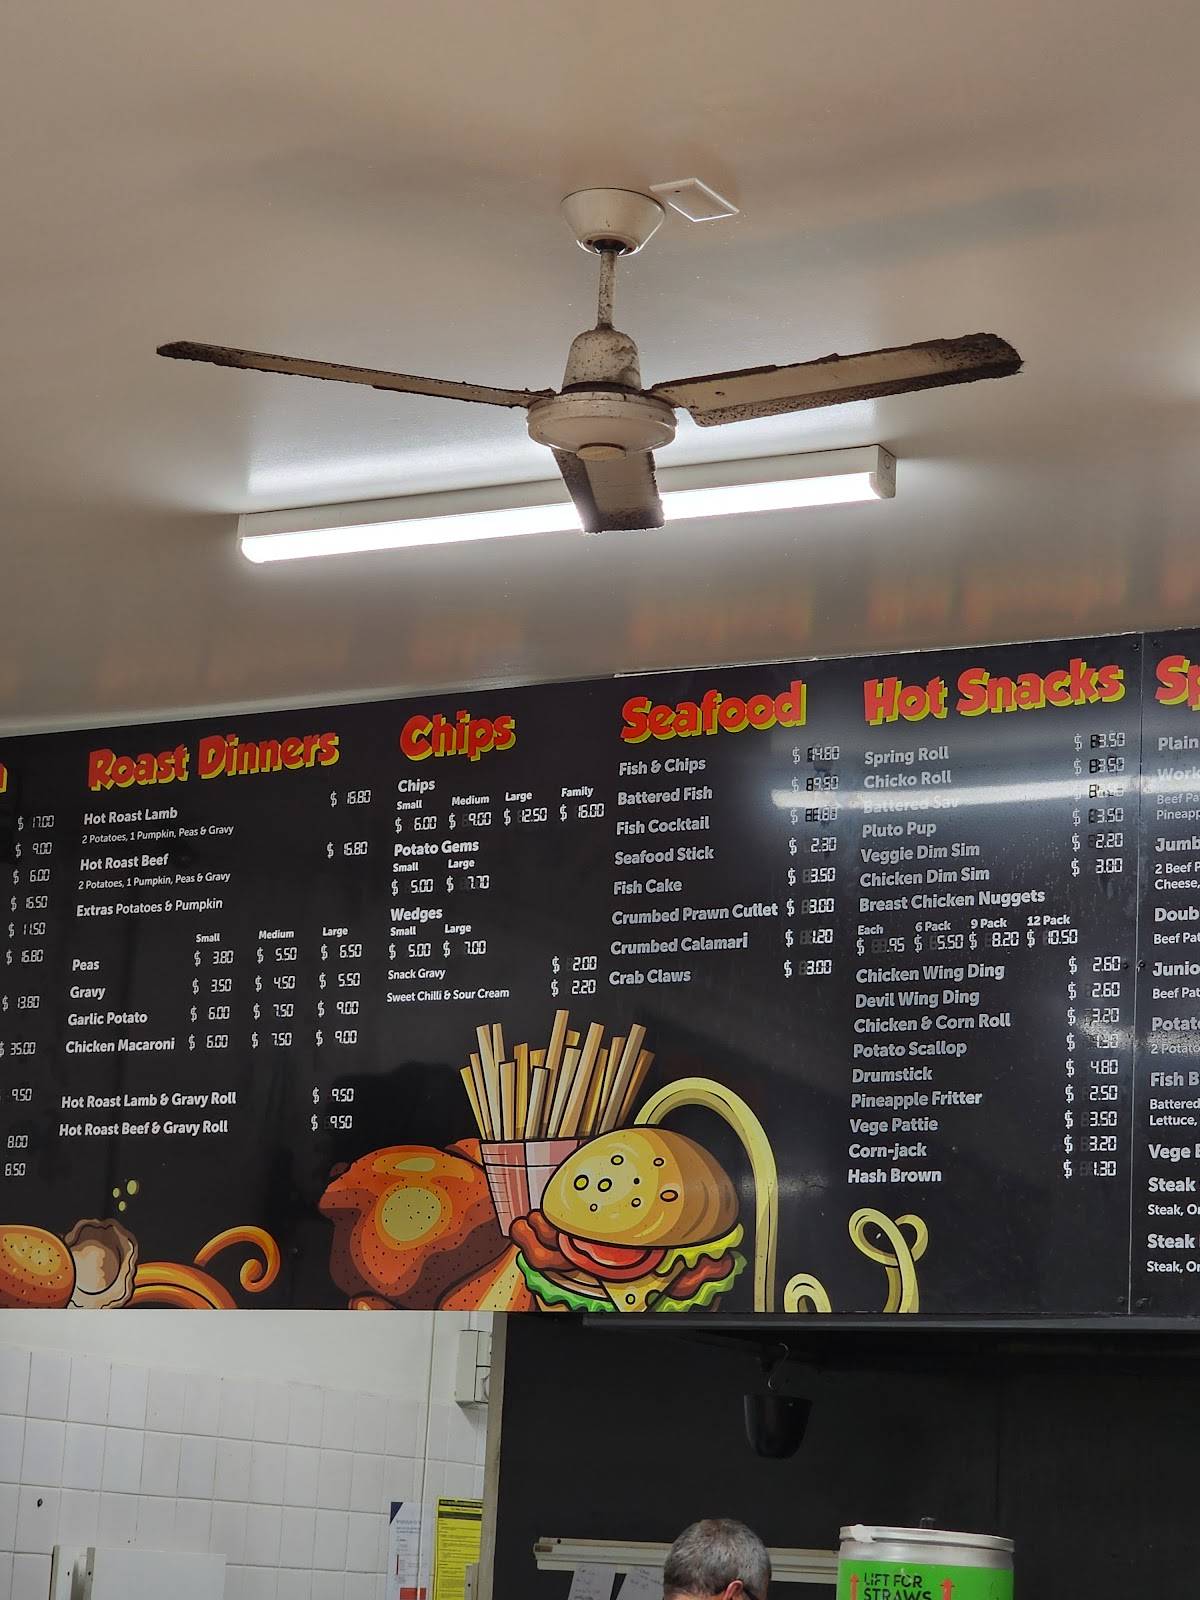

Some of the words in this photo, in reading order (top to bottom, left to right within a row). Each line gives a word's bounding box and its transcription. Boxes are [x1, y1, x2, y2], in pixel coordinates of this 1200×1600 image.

[863, 676, 948, 726] Hot
[956, 658, 1126, 717] Snacks
[620, 679, 807, 744] Seafood
[399, 709, 516, 762] Chips
[1159, 736, 1199, 751] Plain
[88, 744, 190, 792] Roast
[198, 732, 339, 780] Dinners
[865, 750, 914, 767] Spring
[918, 746, 949, 761] Roll
[619, 761, 647, 776] Fish
[651, 760, 661, 773] &
[664, 758, 706, 774] Chips
[398, 779, 435, 794] Chips
[864, 773, 917, 788] Chicko
[921, 770, 951, 784] Roll
[397, 800, 422, 810] Small
[452, 795, 489, 806] Medium
[505, 792, 532, 802] Large
[561, 786, 593, 797] Family
[618, 788, 680, 805] Battered
[684, 786, 712, 800] Fish
[84, 813, 106, 825] Hot
[109, 810, 142, 823] Roast
[145, 807, 177, 820] Lamb
[617, 821, 645, 835] Fish
[648, 816, 709, 833] Cocktail
[863, 824, 903, 838] Pluto
[907, 822, 936, 837] Pup
[82, 835, 87, 844] 2
[89, 833, 128, 843] Potatoes,
[137, 829, 176, 840] Pumpkin,
[179, 828, 198, 837] Peas
[200, 826, 206, 835] &
[208, 825, 234, 835] Gravy
[394, 843, 439, 856] Potato
[441, 840, 479, 853] Gems
[615, 848, 674, 865] Seafood
[677, 846, 714, 861] Stick
[861, 847, 913, 865] Veggie
[917, 845, 947, 859] Dim
[951, 843, 979, 857] Sim
[80, 859, 102, 870] Hot
[105, 856, 139, 869] Roast
[142, 853, 169, 866] Beef
[393, 862, 418, 872] Small
[448, 859, 475, 870] Large
[1155, 864, 1162, 874] 2
[1166, 862, 1192, 873] Beef
[860, 871, 922, 887] Chicken
[927, 869, 957, 883] Dim
[961, 867, 989, 881] Sim
[614, 880, 642, 895] Fish
[646, 878, 682, 893] Cake
[77, 905, 113, 916] Extras
[116, 902, 162, 914] Potatoes
[165, 900, 173, 911] &
[175, 898, 223, 912] Pumpkin
[860, 897, 908, 912] Breast
[911, 893, 974, 909] Chicken
[979, 890, 1045, 907] Nuggets
[391, 907, 442, 923] Wedges
[612, 908, 679, 925] Crumbed
[683, 907, 729, 921] Prawn
[1155, 906, 1199, 922] Doub
[858, 924, 883, 935] Each
[915, 922, 922, 932] 6
[925, 921, 951, 931] Pack
[971, 919, 978, 929] 9
[981, 918, 1007, 928] Pack
[1027, 916, 1040, 926] 12
[1043, 915, 1070, 925] Pack
[196, 933, 220, 942] Small
[259, 930, 294, 939] Medium
[323, 927, 348, 938] Large
[611, 938, 678, 955] Crumbed
[681, 932, 748, 951] Calamari
[72, 959, 99, 971] Peas
[856, 968, 919, 983] Chicken
[923, 965, 964, 982] Wing
[968, 963, 1005, 980] Ding
[388, 969, 416, 980] Snack
[418, 968, 446, 980] Gravy
[609, 970, 644, 985] Crab
[647, 969, 691, 983] Claws
[70, 986, 105, 1000] Gravy
[387, 992, 415, 1002] Sweet
[417, 991, 442, 1001] Chilli
[444, 990, 451, 1000] &
[453, 990, 476, 999] Sour
[477, 988, 509, 998] Cream
[856, 993, 895, 1008] Devil
[898, 991, 938, 1008] Wing
[943, 990, 979, 1006] Ding
[68, 1013, 104, 1026] Garlic
[107, 1012, 147, 1024] Potato
[854, 1018, 917, 1033] Chicken
[921, 1016, 932, 1030] &
[936, 1015, 974, 1029] Corn
[979, 1013, 1010, 1027] Roll
[66, 1040, 115, 1053] Chicken
[118, 1037, 175, 1051] Macaroni
[854, 1044, 905, 1058] Potato
[909, 1040, 967, 1057] Scallop
[852, 1066, 932, 1083] Drumstick
[1151, 1072, 1183, 1086] Fish
[62, 1096, 84, 1108] Hot
[87, 1095, 121, 1107] Roast
[124, 1094, 157, 1106] Lamb
[160, 1093, 169, 1106] &
[172, 1093, 209, 1108] Gravy
[211, 1092, 236, 1104] Roll
[851, 1092, 928, 1110] Pineapple
[932, 1091, 982, 1105] Fritter
[1150, 1098, 1200, 1109] Battered
[59, 1124, 82, 1136] Hot
[85, 1123, 119, 1135] Roast
[122, 1122, 150, 1134] Beef
[152, 1122, 161, 1134] &
[163, 1121, 200, 1136] Gravy
[203, 1120, 228, 1133] Roll
[850, 1119, 888, 1136] Vege
[892, 1117, 938, 1132] Pattie
[1150, 1115, 1197, 1126] Lettuce,
[849, 1142, 927, 1160] Corn-jack
[1148, 1144, 1191, 1162] Vege
[848, 1169, 886, 1183] Hash
[891, 1168, 941, 1182] Brown
[1148, 1177, 1196, 1192] Steak
[1148, 1204, 1184, 1216] Steak,
[1147, 1234, 1195, 1248] Steak
[1147, 1261, 1183, 1273] Steak,
[894, 1575, 923, 1588] FOR
[864, 1588, 932, 1600] STRAWS
